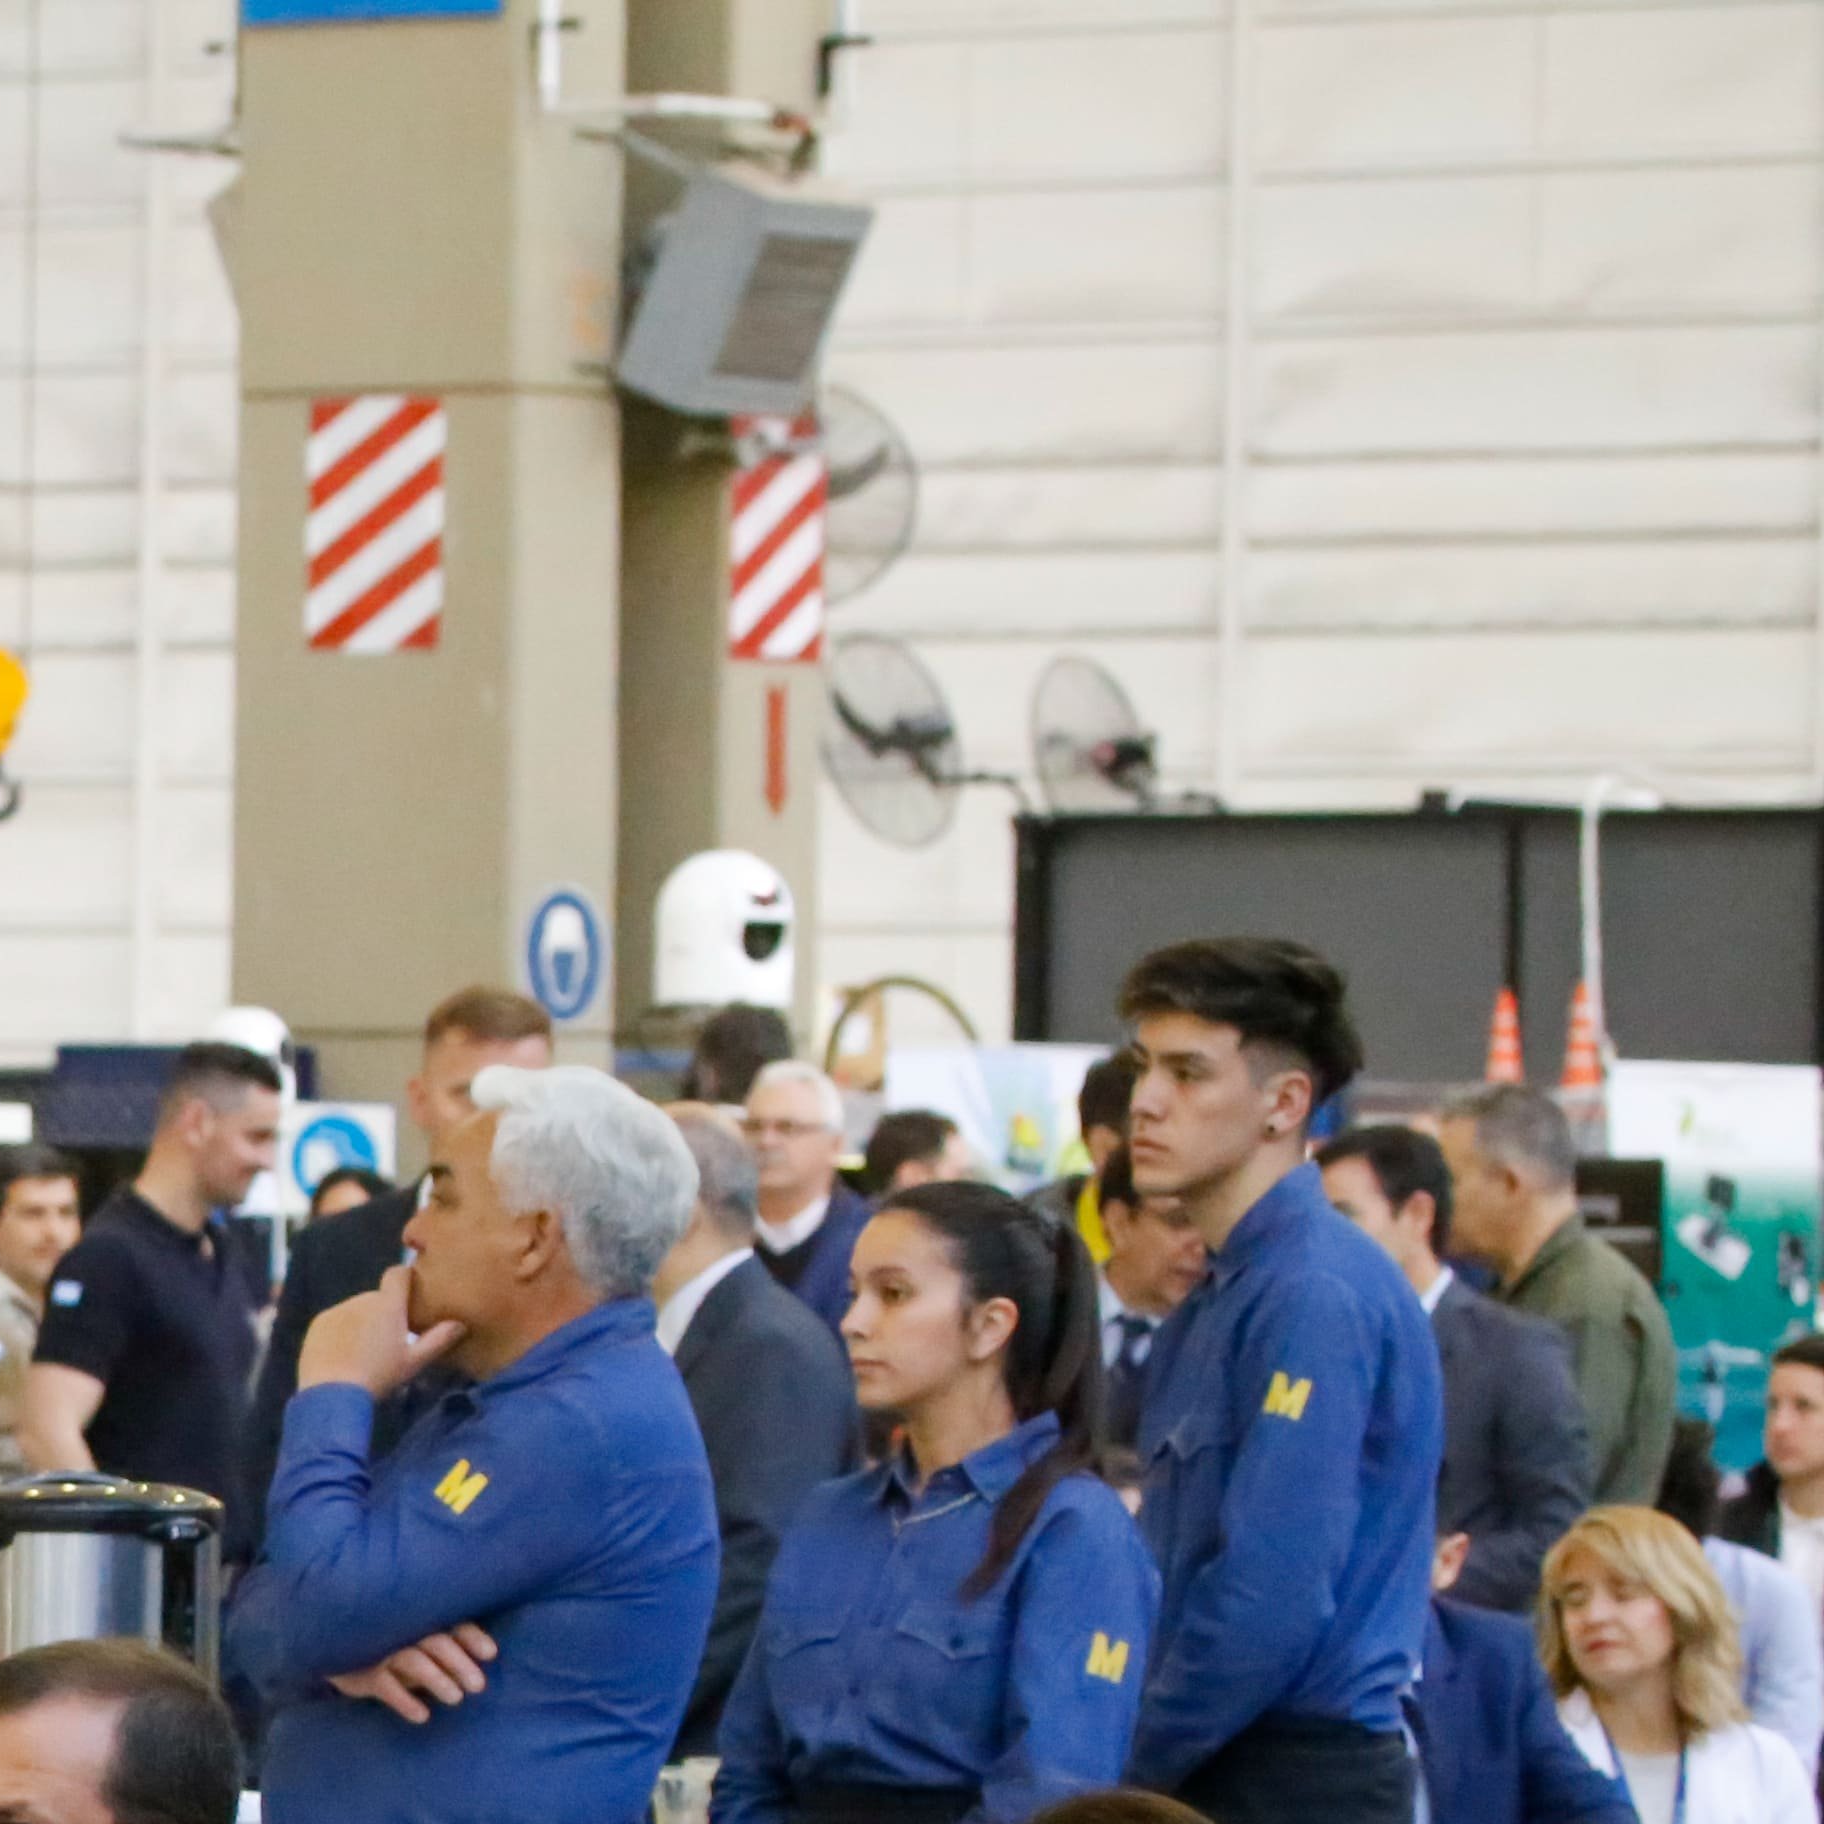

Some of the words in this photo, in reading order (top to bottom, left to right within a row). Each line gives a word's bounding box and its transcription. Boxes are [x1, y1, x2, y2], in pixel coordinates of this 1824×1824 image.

[1265, 1371, 1312, 1420] M
[434, 1459, 488, 1514] M
[1086, 1631, 1129, 1684] M
